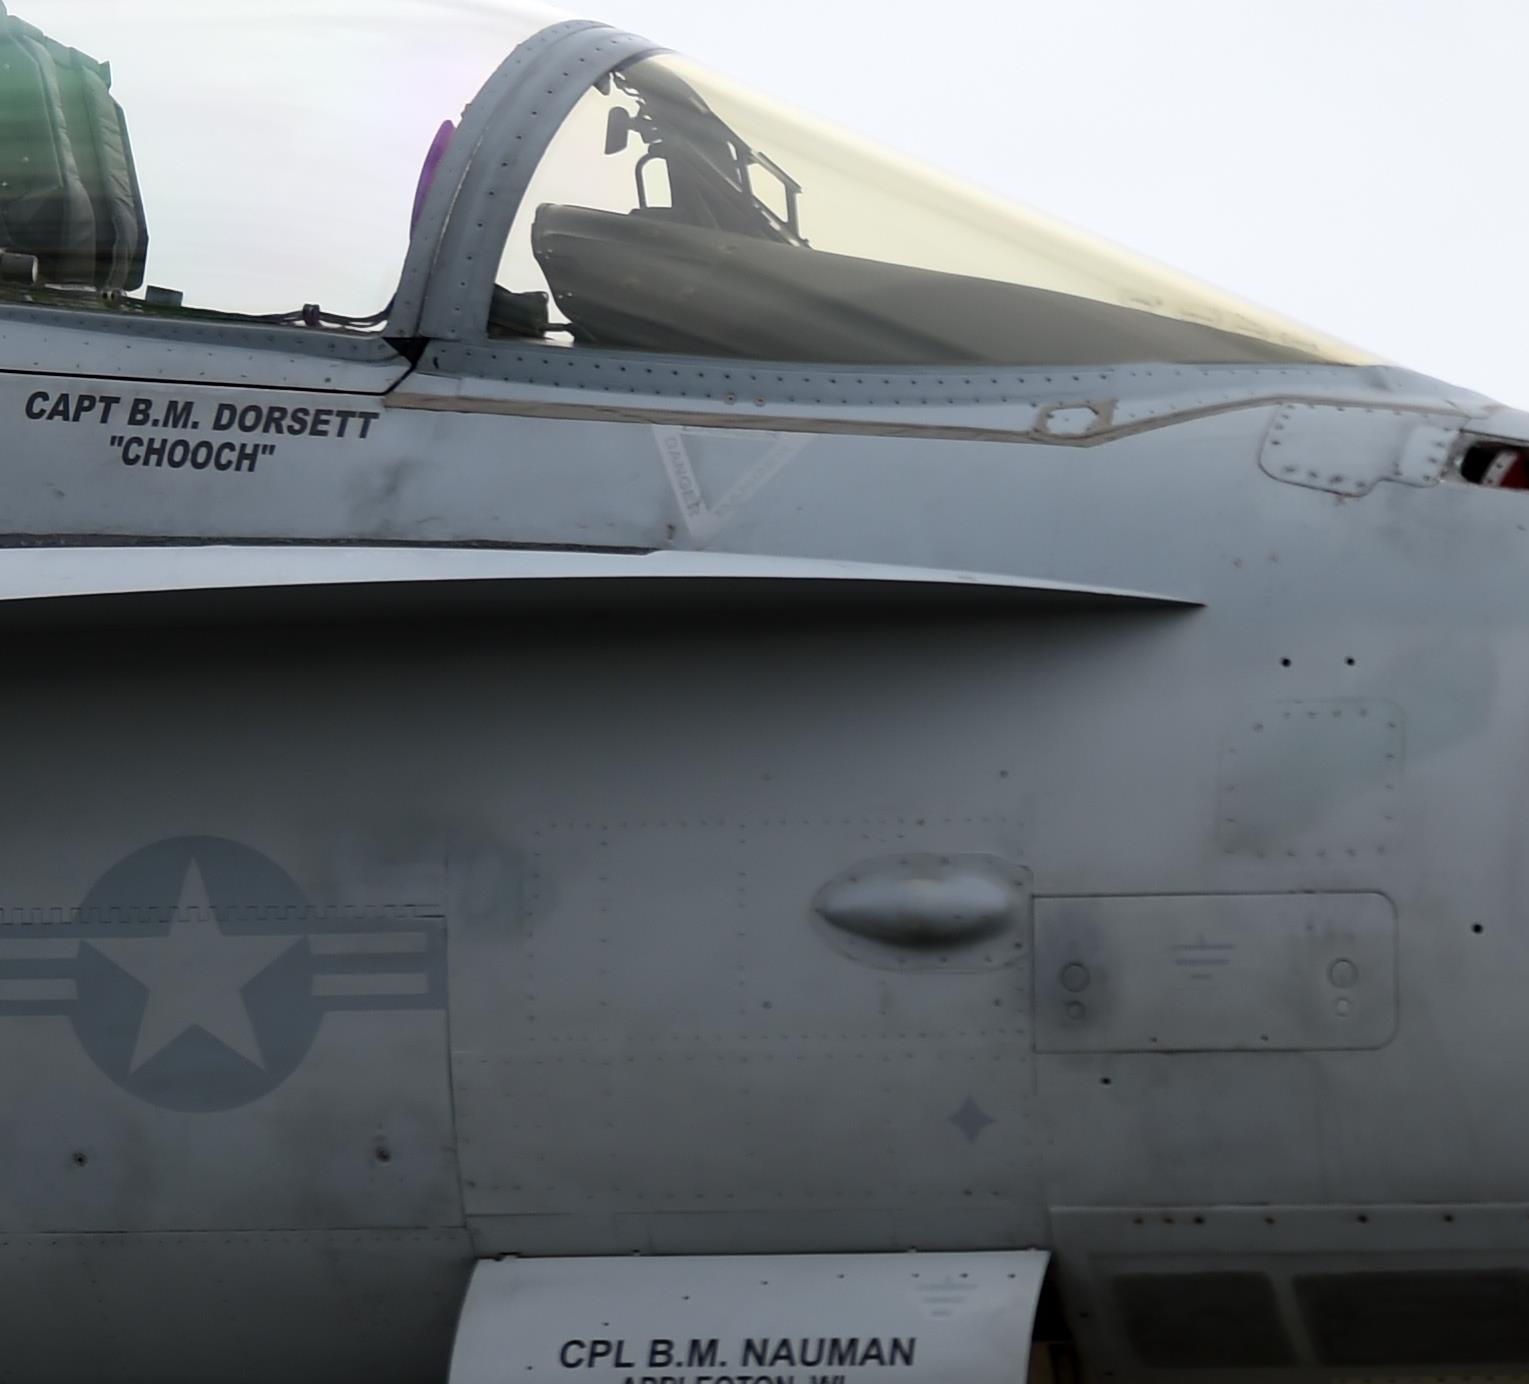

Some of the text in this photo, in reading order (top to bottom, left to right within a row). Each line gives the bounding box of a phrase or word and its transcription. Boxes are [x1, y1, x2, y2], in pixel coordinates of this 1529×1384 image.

[25, 391, 379, 439] CAPT B.M. DORSETT
[109, 436, 275, 472] "CHOOCH"
[559, 1337, 916, 1369] CPL B.M. NAUMAN
